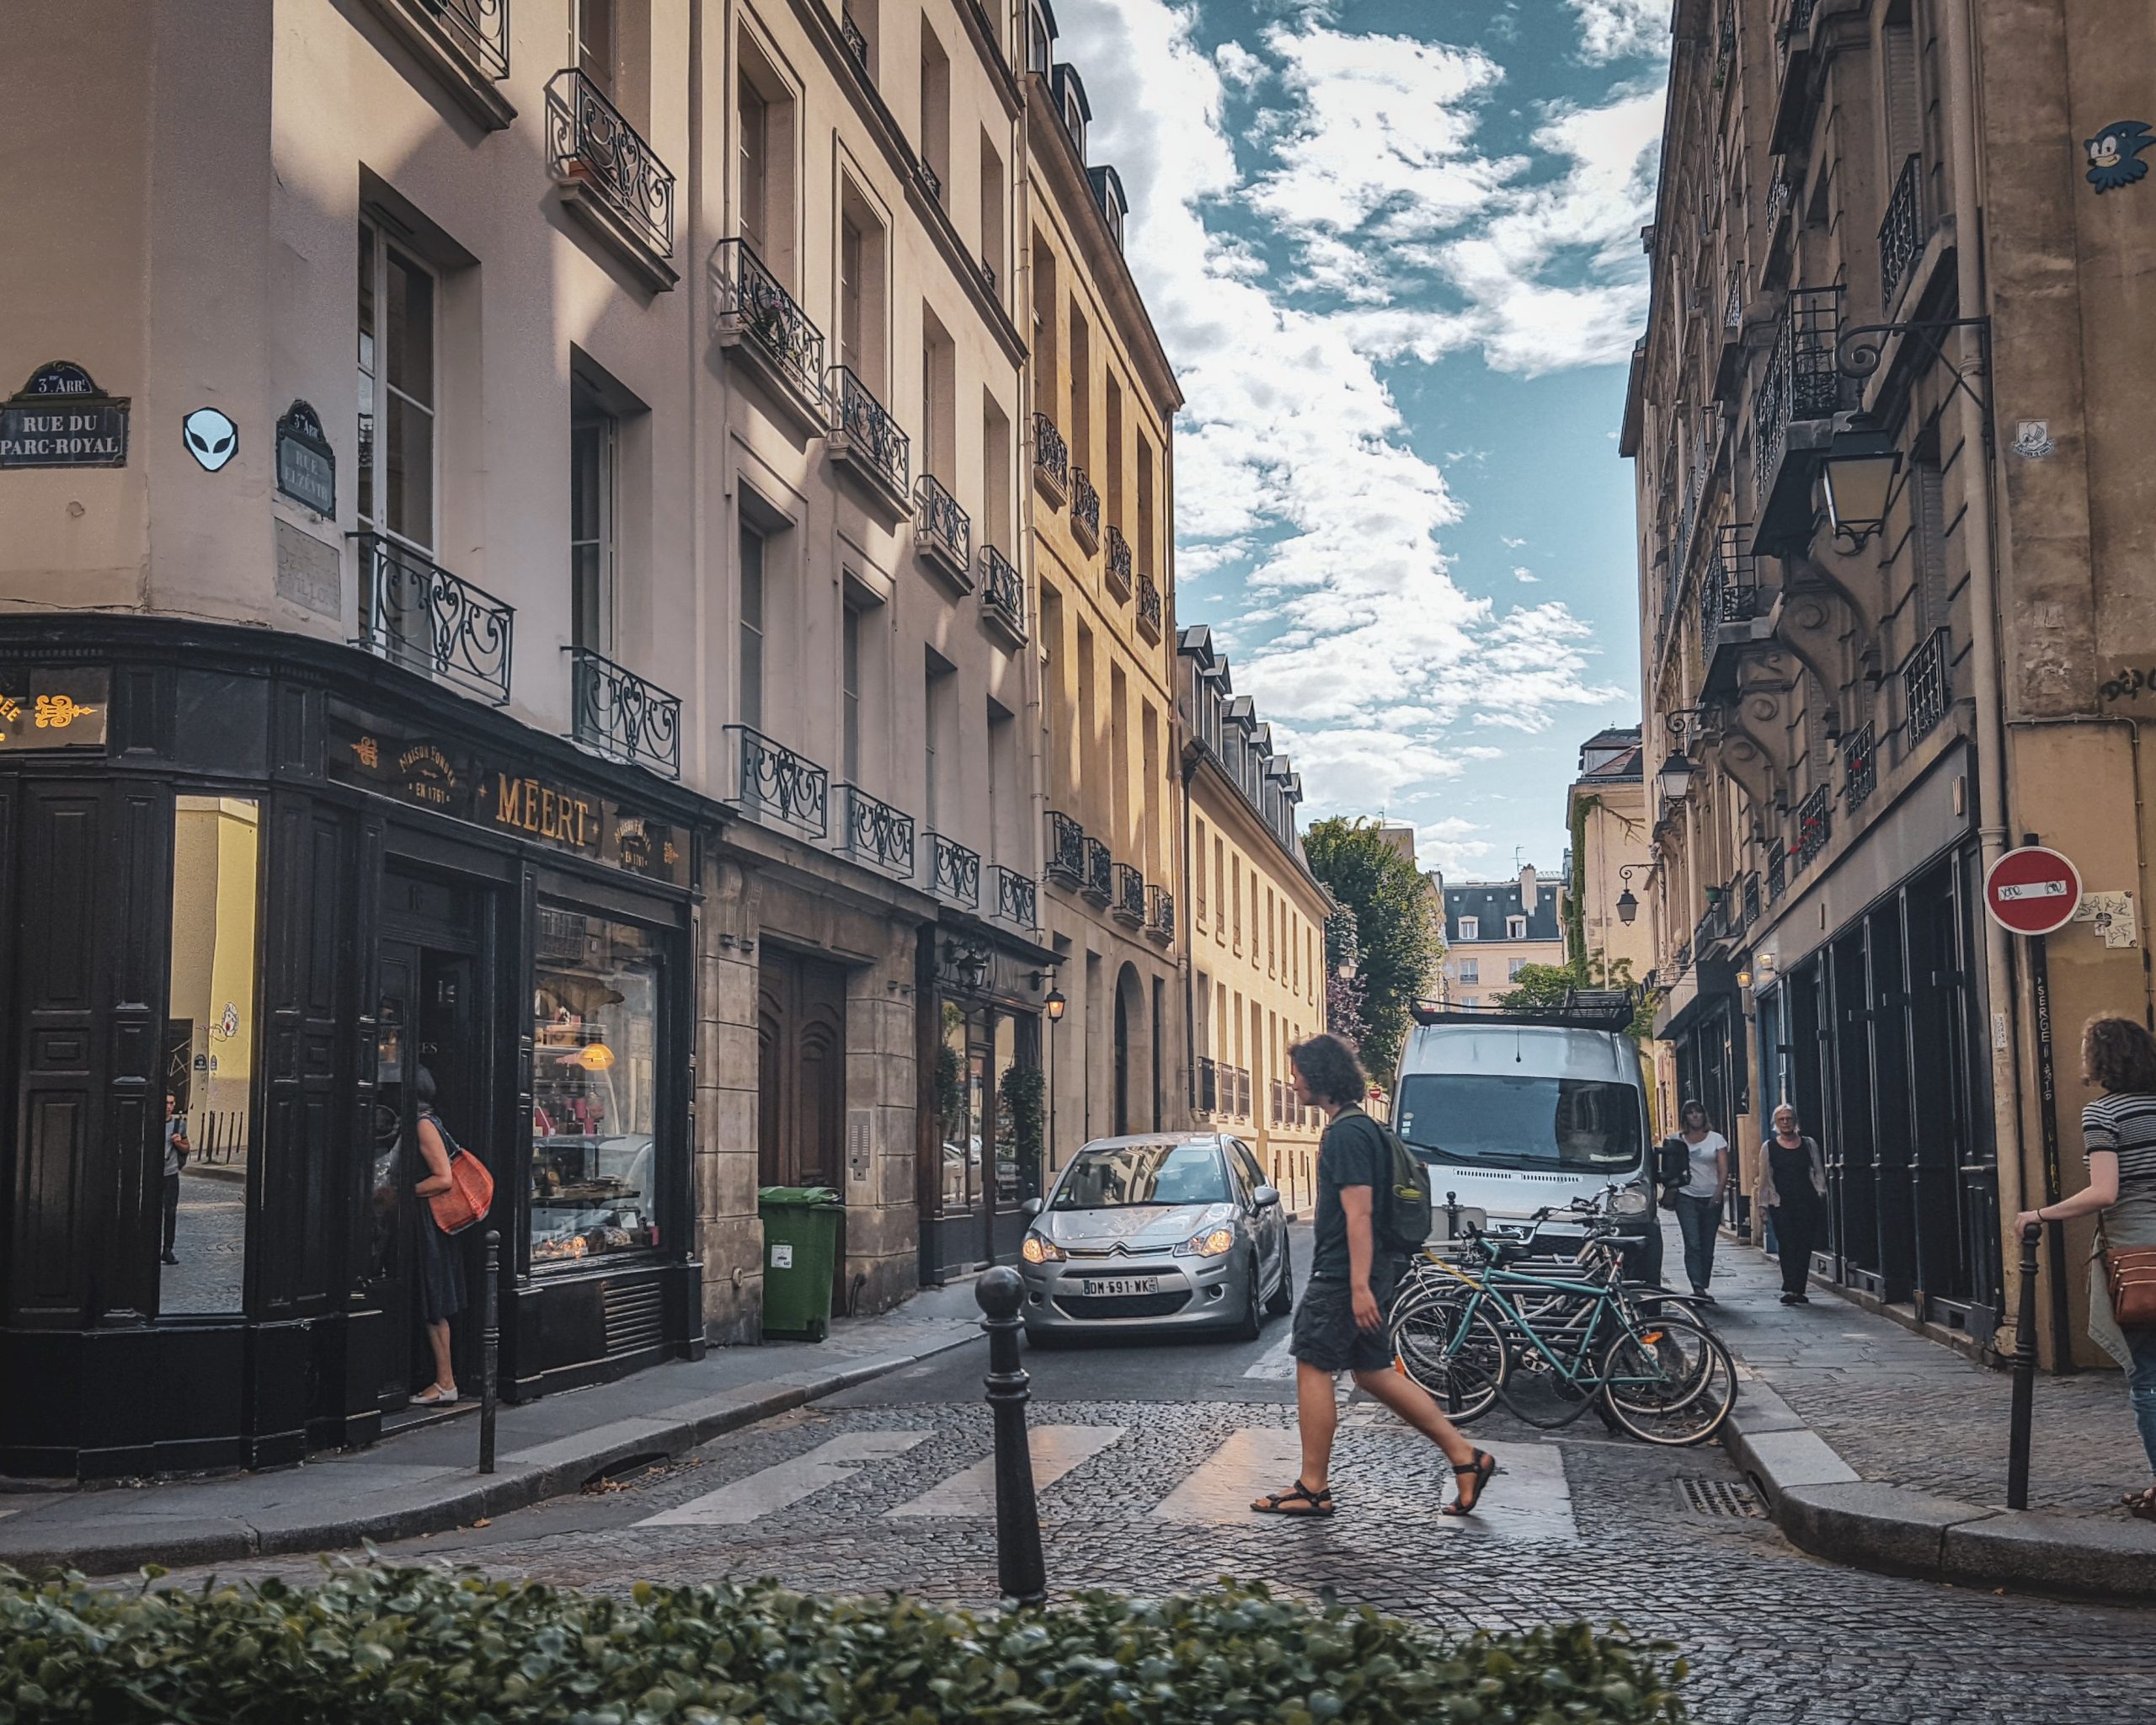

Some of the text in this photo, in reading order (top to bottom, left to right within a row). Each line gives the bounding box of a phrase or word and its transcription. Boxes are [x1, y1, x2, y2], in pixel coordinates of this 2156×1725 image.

[23, 415, 97, 432] RUE DU
[0, 438, 118, 455] PARC-ROYAL
[296, 451, 318, 474] RUE
[0, 694, 21, 722] ÉE
[399, 746, 429, 773] MAISON
[416, 782, 425, 798] EN
